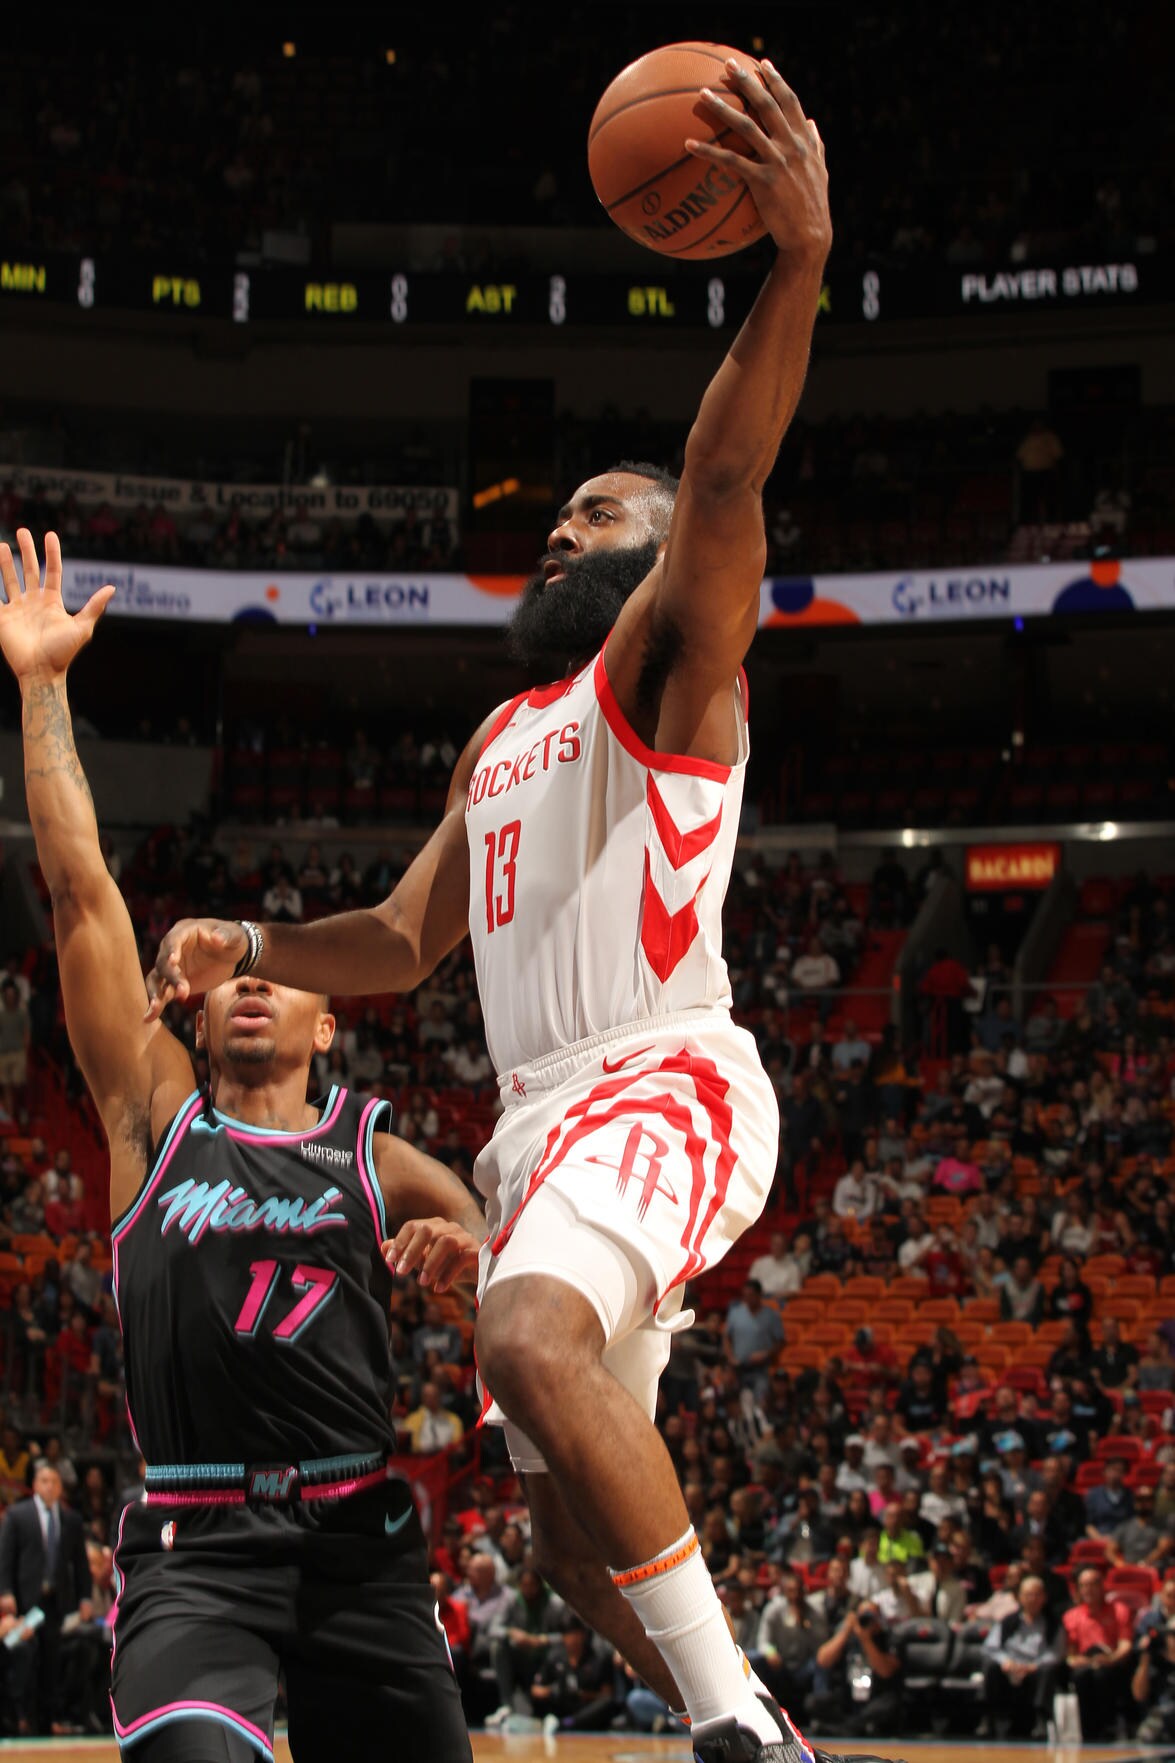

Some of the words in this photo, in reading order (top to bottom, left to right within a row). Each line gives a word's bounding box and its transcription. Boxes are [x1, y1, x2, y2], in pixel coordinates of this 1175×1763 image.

[642, 163, 738, 242] ALDING
[305, 282, 358, 311] REB
[962, 270, 1057, 302] PLAYER
[1062, 263, 1138, 296] STATS
[347, 583, 429, 607] LEON
[929, 577, 1010, 604] LEON
[484, 818, 522, 935] 13
[158, 1178, 348, 1246] Miami
[234, 1259, 340, 1343] 17
